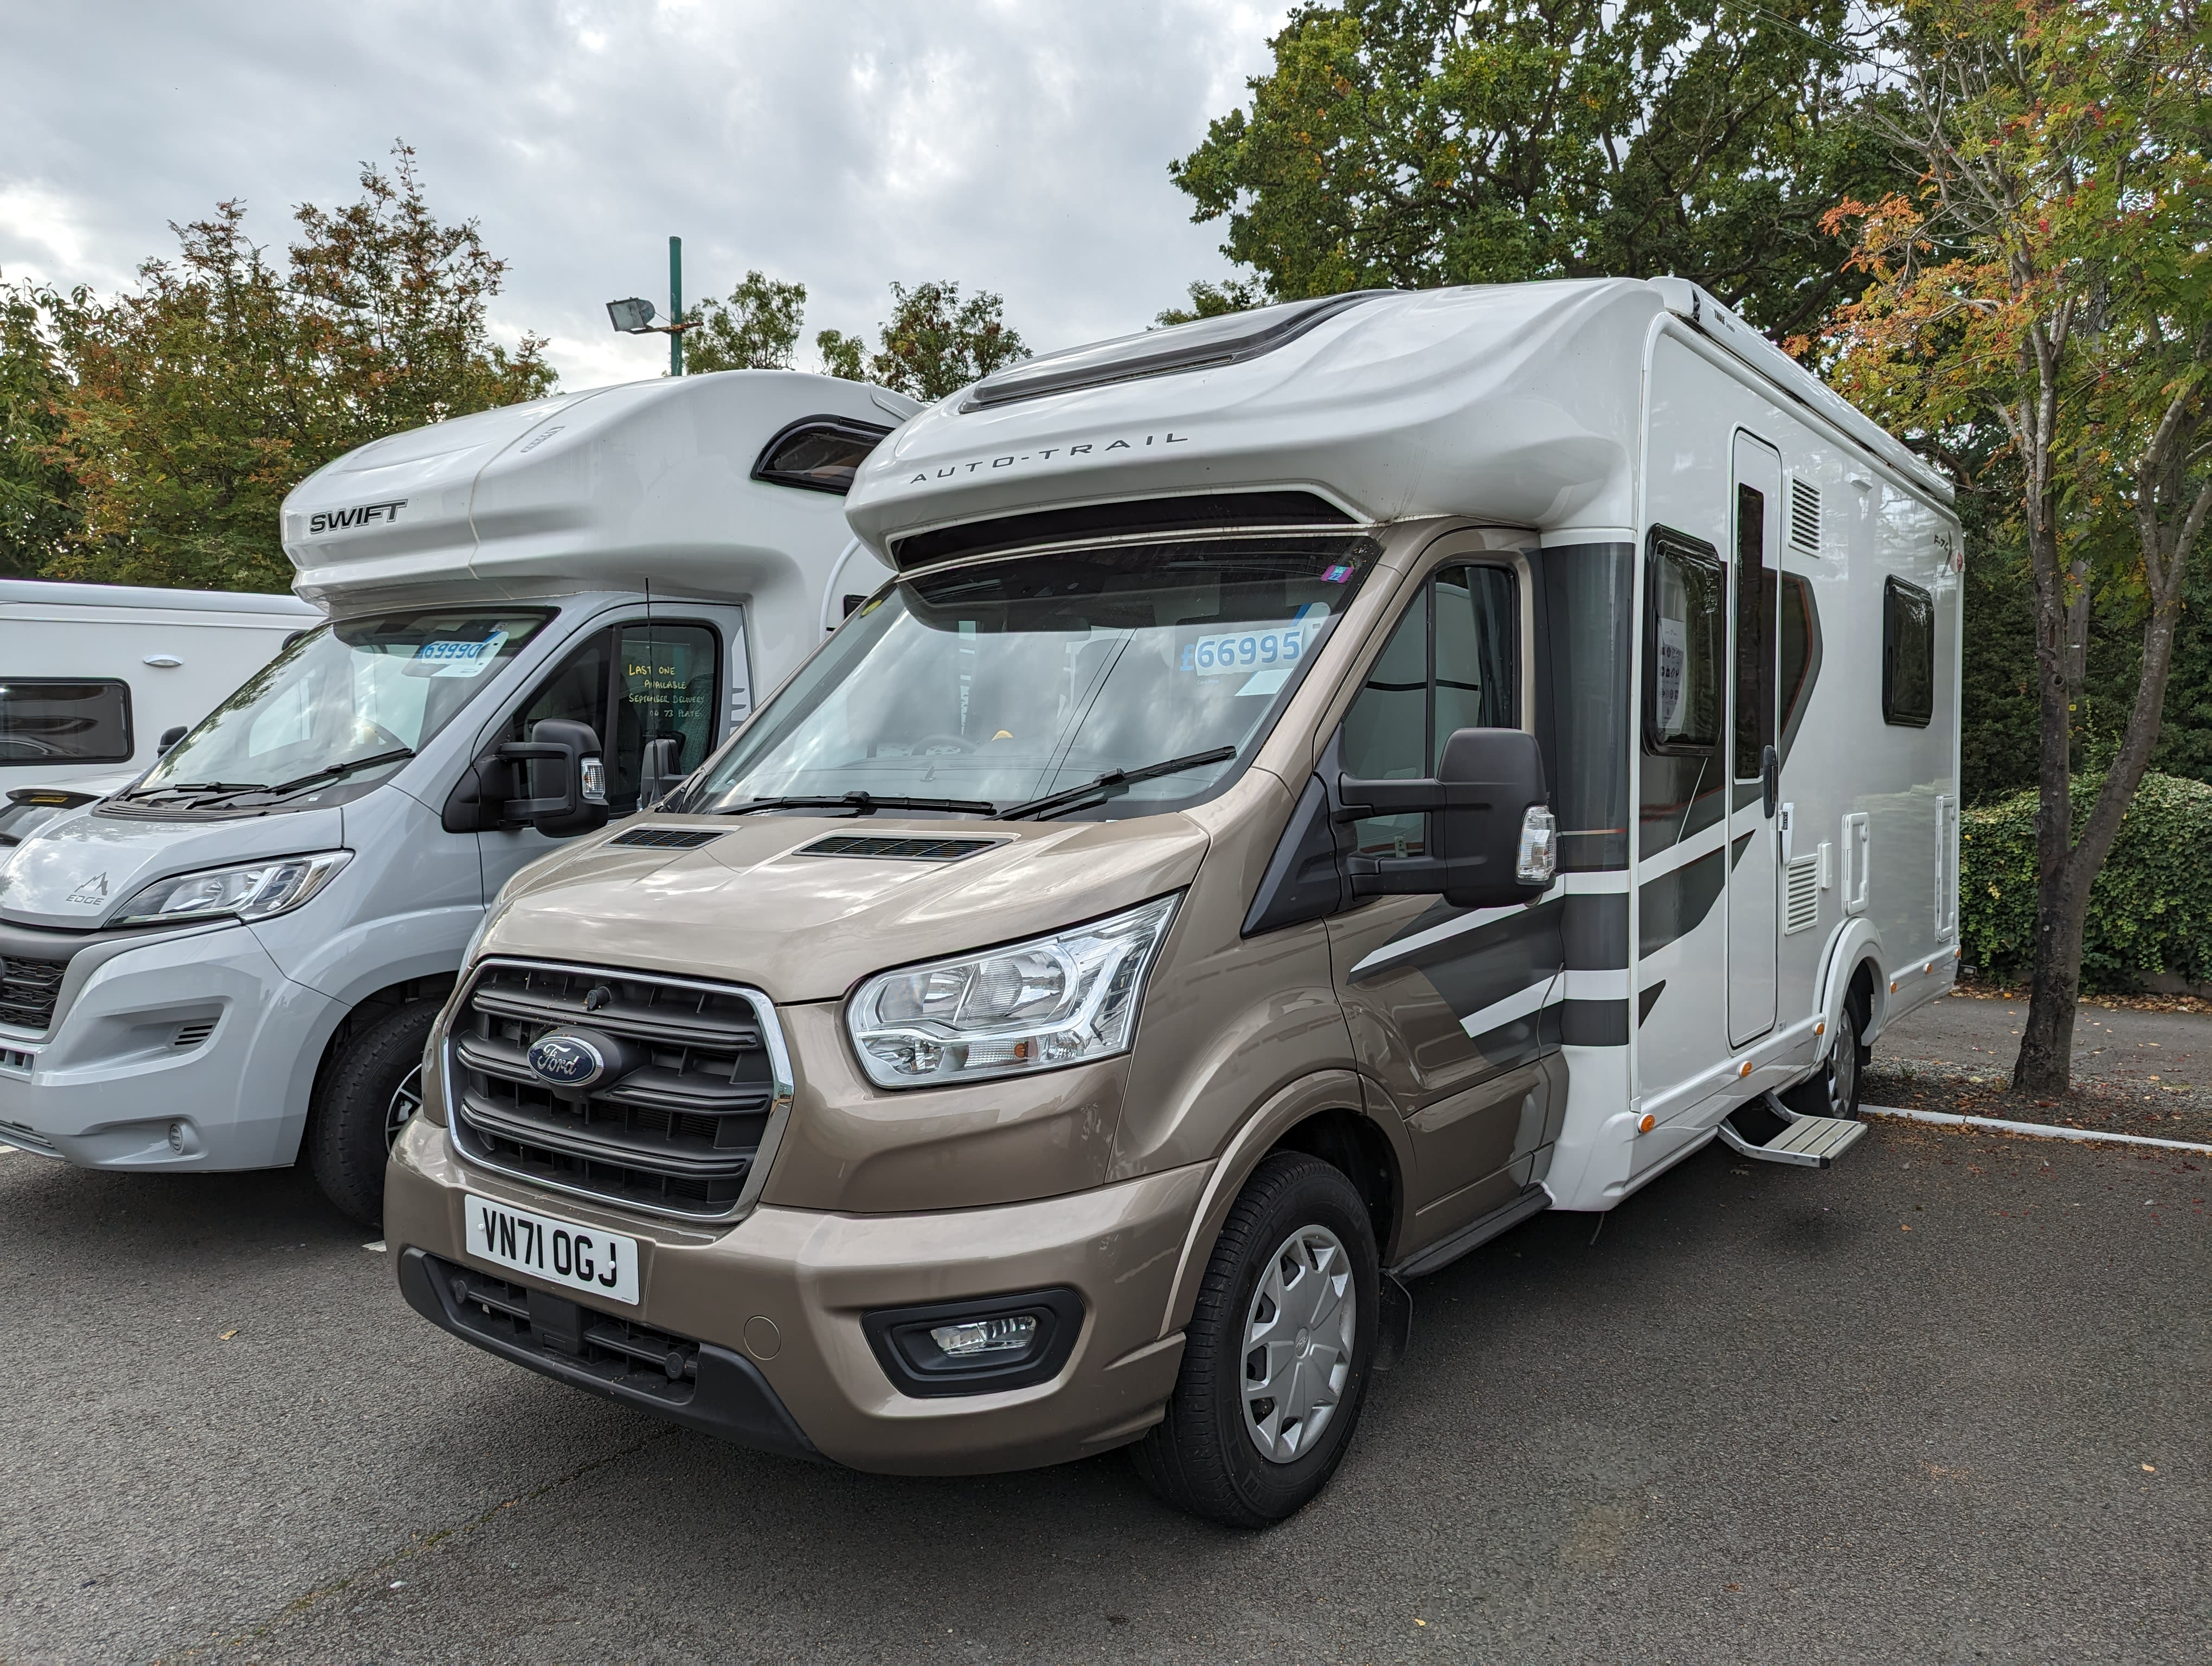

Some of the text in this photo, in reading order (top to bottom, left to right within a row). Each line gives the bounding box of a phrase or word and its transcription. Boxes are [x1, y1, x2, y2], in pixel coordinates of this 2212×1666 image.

[910, 433, 1188, 484] AUTO-TRAIL
[310, 499, 408, 534] SWIFT
[629, 664, 676, 676] LAST ONE
[673, 695, 705, 703] DELIVERY
[66, 894, 104, 905] EDGE
[537, 1043, 580, 1075] Ford
[482, 1207, 617, 1288] VN71 OGJ
